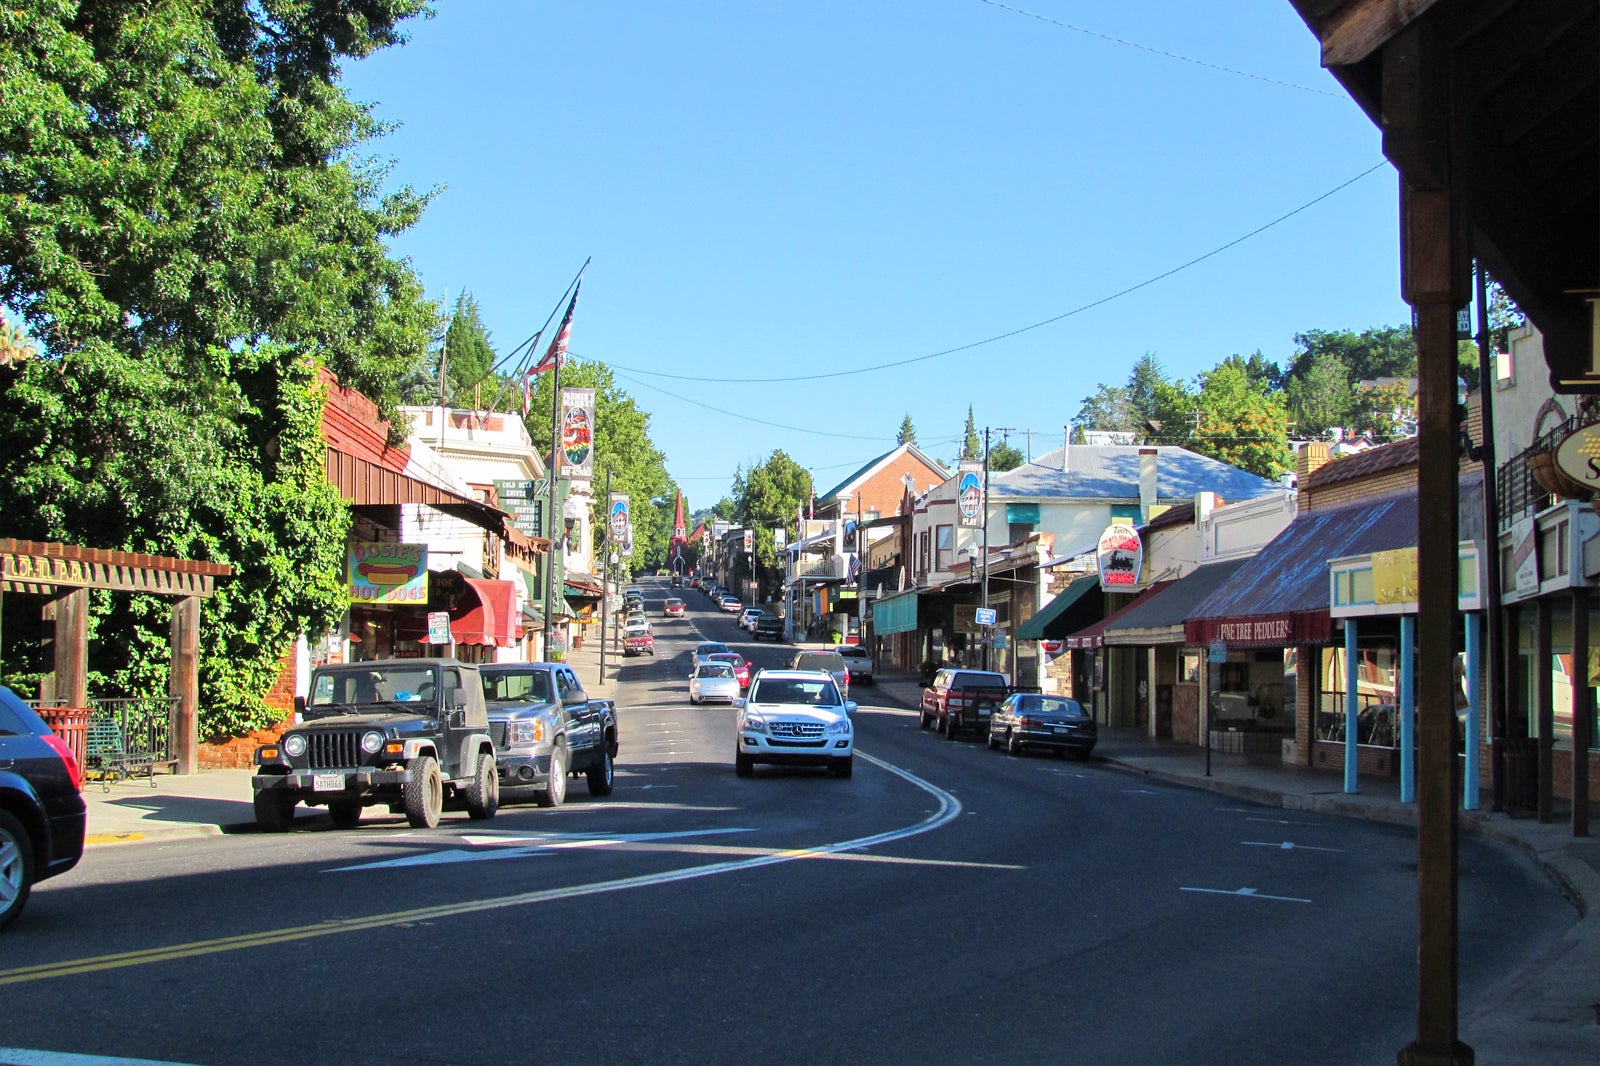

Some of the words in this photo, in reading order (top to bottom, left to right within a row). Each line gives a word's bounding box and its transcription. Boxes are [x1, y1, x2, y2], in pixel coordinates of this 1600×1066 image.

[962, 518, 978, 526] PLAY
[353, 543, 424, 562] ROSIE'S
[349, 585, 380, 600] HOT
[386, 585, 426, 601] DOGS
[1220, 623, 1235, 640] PINE
[1235, 623, 1252, 639] TREE
[1254, 620, 1289, 640] PEDDLERS
